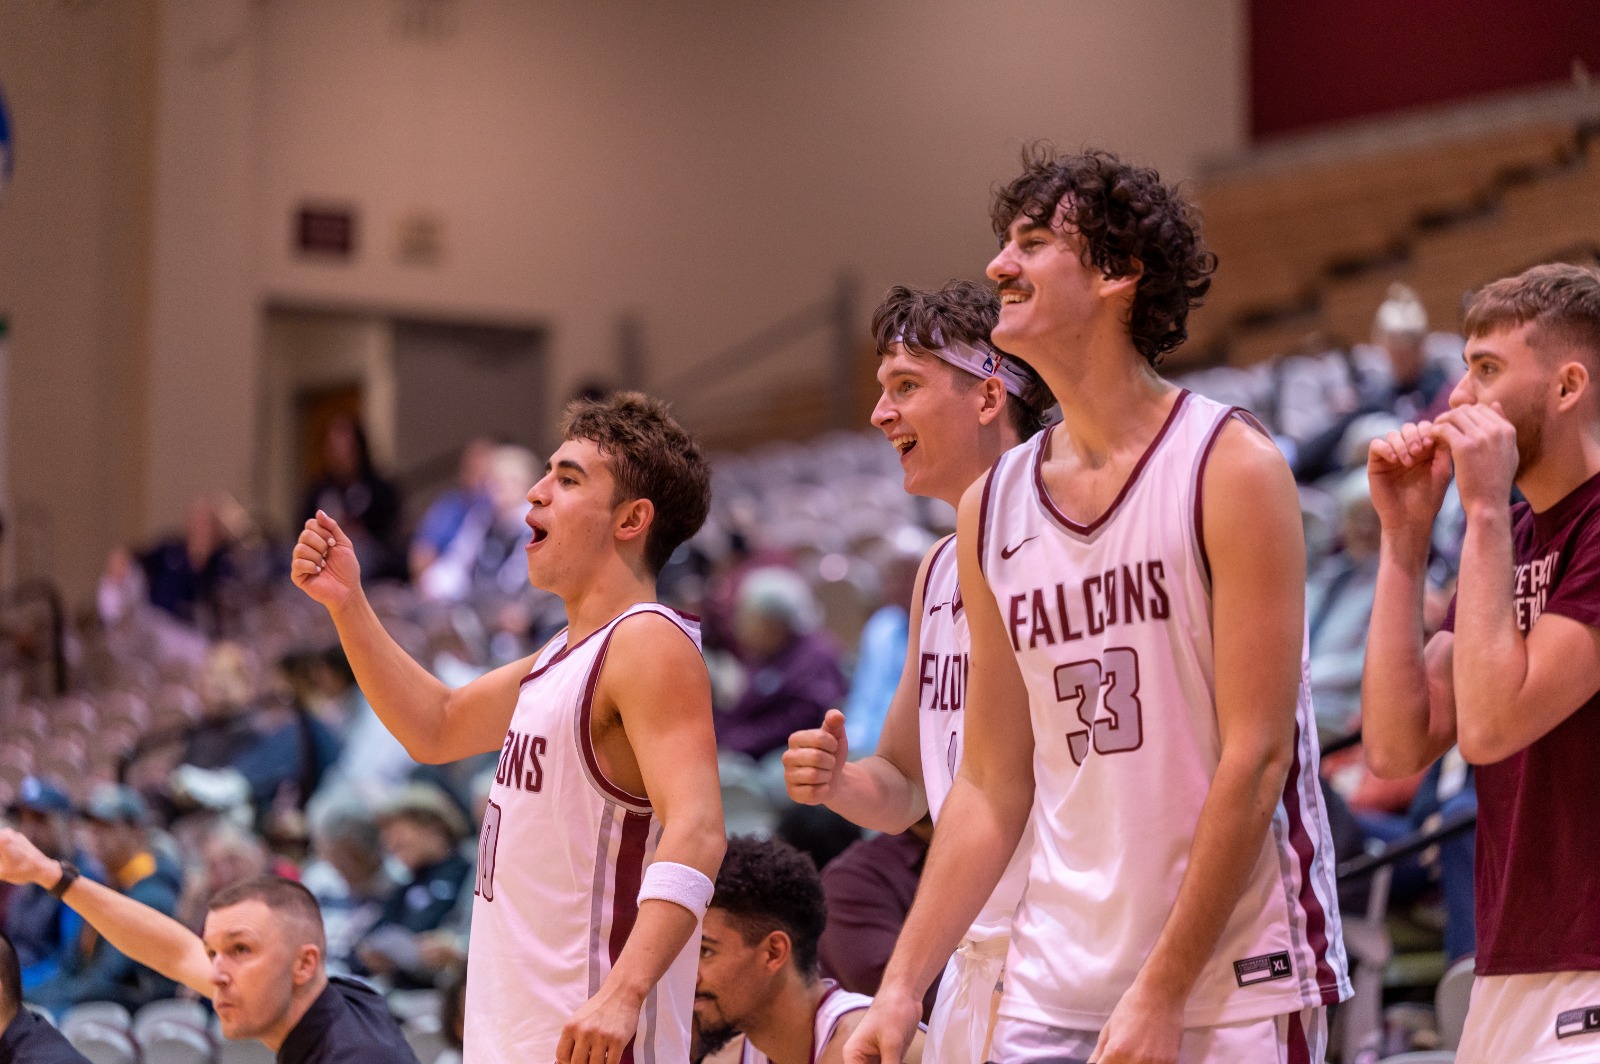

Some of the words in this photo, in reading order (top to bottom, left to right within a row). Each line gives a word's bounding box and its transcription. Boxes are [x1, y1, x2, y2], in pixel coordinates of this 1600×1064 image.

[1009, 559, 1170, 651] FALCONS
[1053, 646, 1144, 767] 33
[1272, 959, 1288, 972] XL
[1589, 1012, 1599, 1026] L
